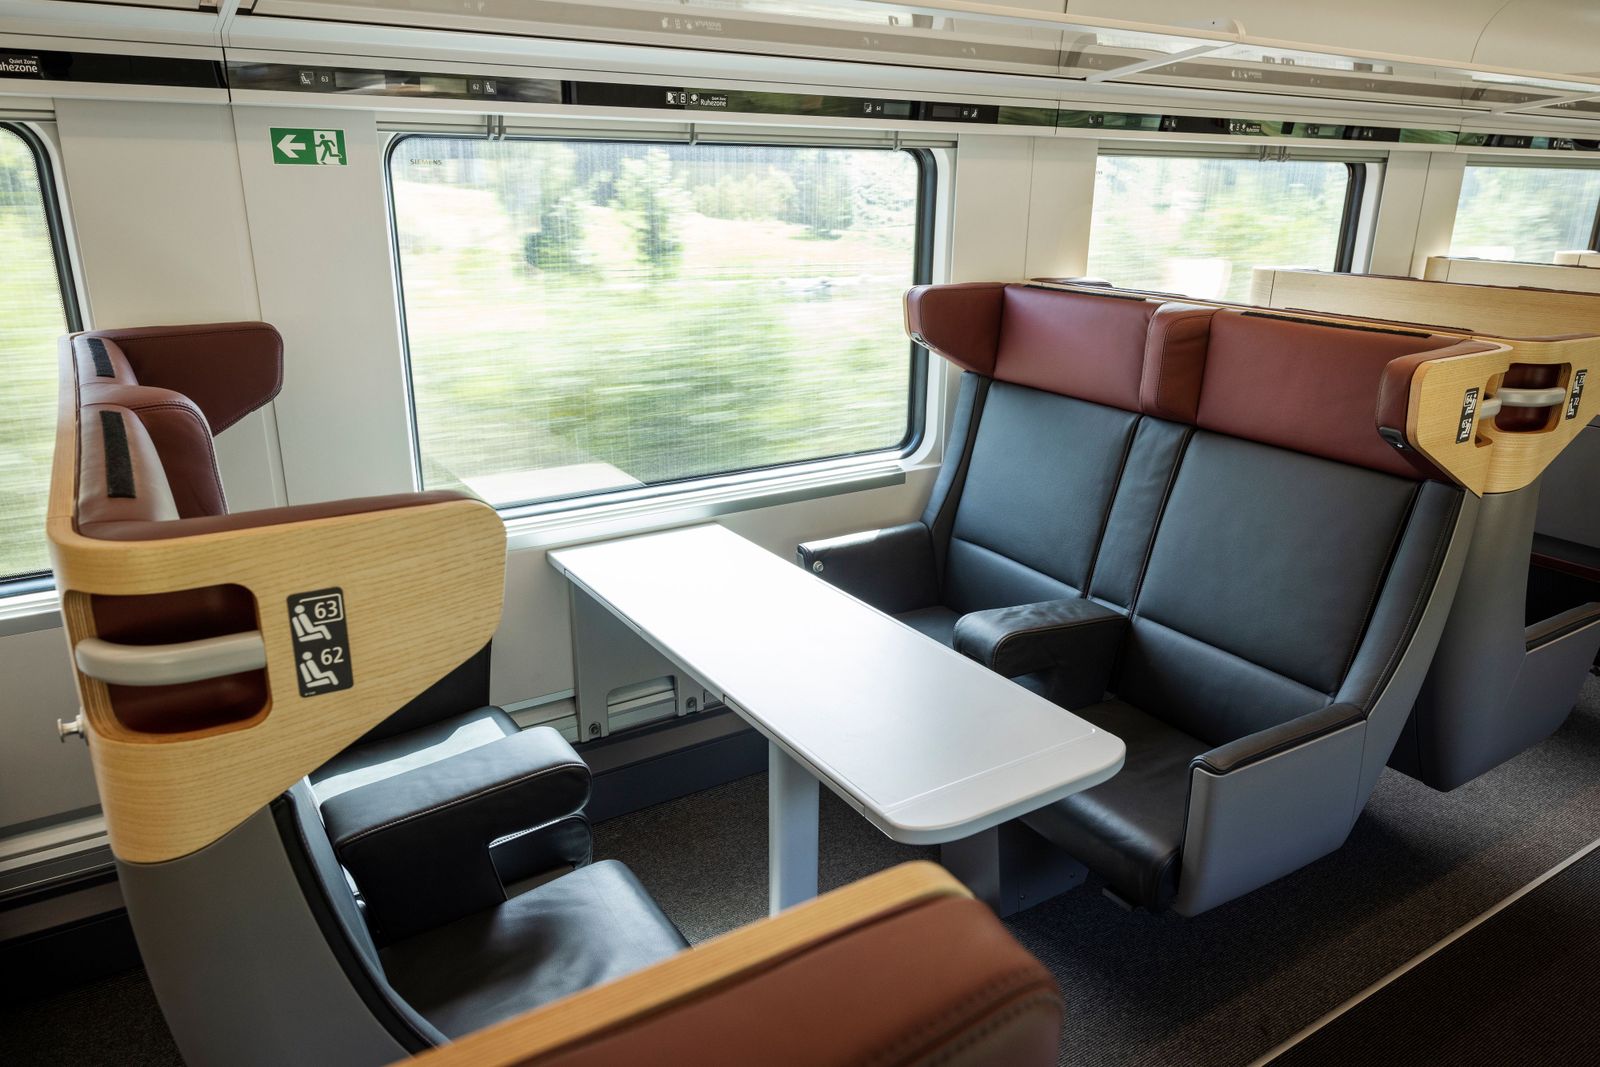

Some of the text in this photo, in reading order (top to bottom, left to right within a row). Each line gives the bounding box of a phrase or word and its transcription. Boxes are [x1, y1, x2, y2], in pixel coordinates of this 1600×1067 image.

[321, 75, 328, 83] 63
[700, 98, 727, 107] Ruhezone
[314, 600, 338, 619] 63
[320, 646, 344, 666] 62
